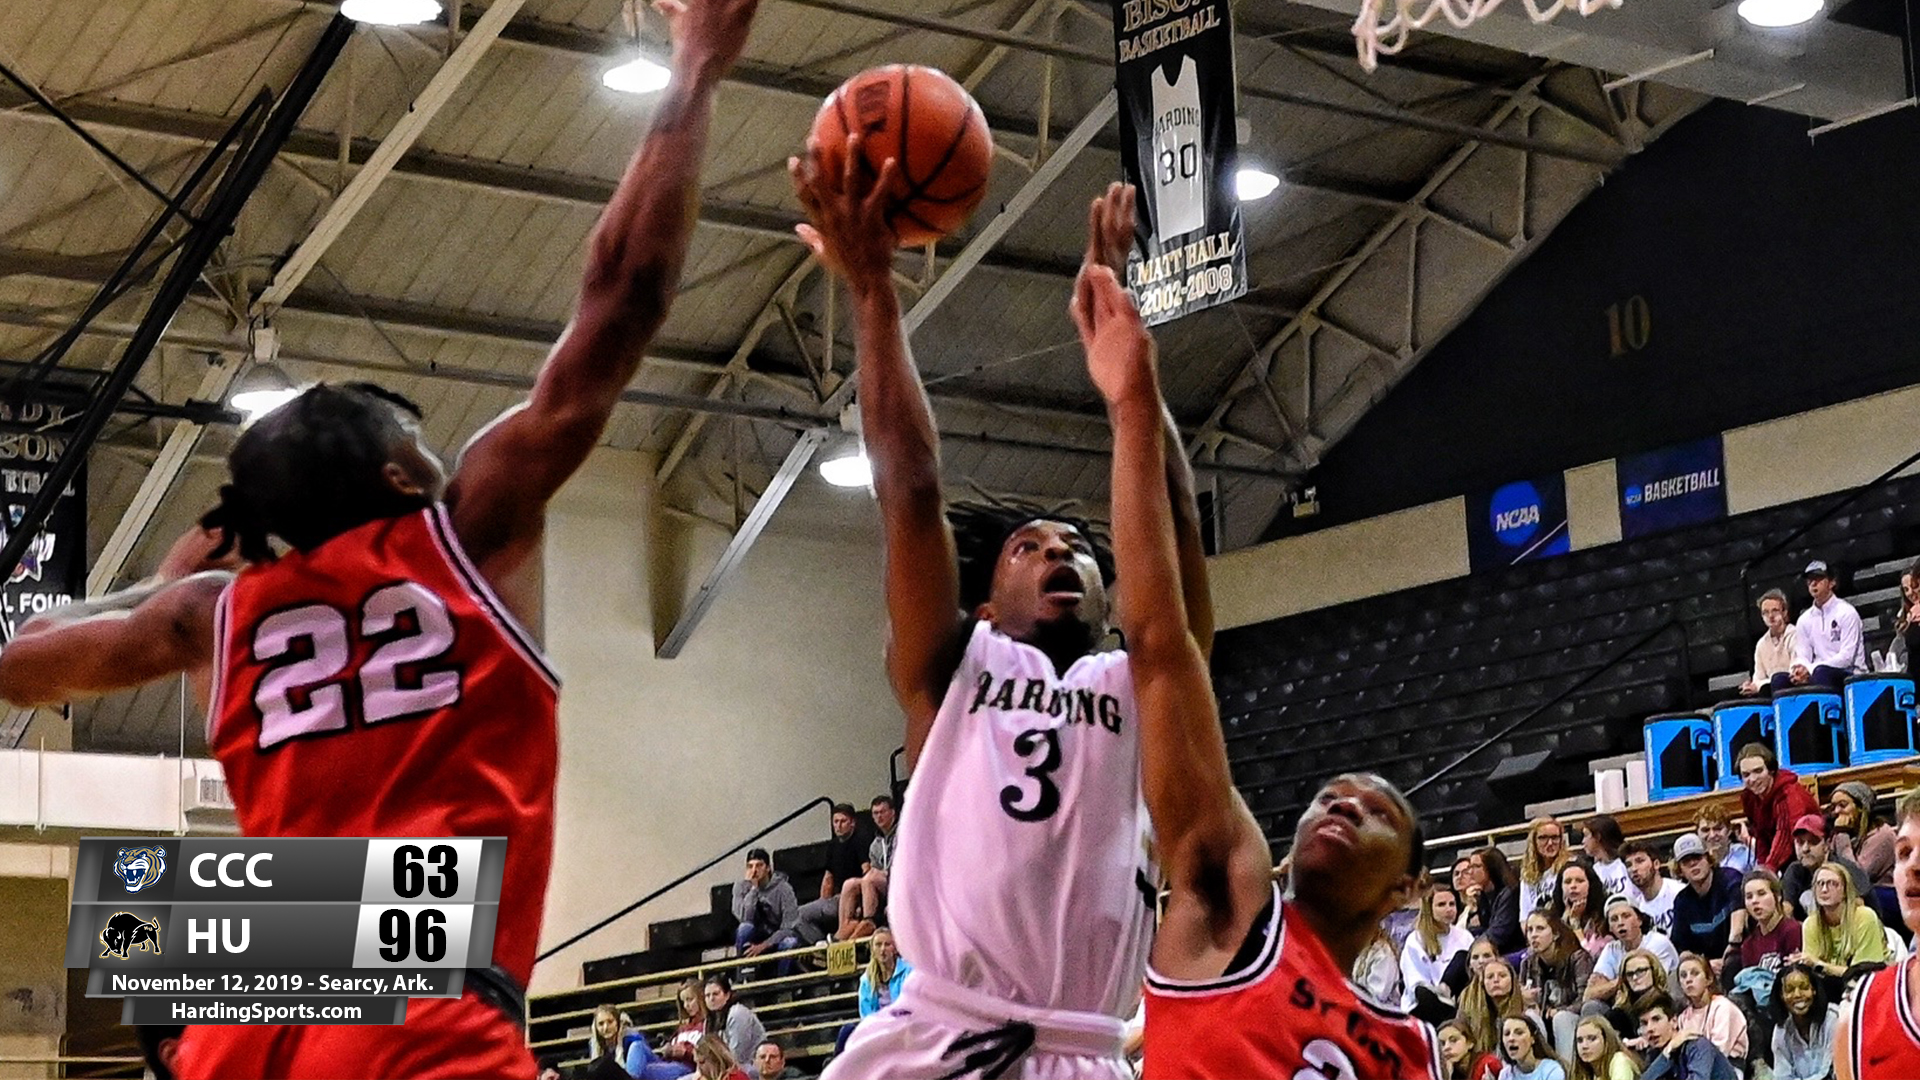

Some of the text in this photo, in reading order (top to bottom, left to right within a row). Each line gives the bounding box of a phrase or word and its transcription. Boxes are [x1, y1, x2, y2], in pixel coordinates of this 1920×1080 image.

[1119, 5, 1220, 63] BASKETBALL
[1160, 142, 1197, 187] 30
[1136, 231, 1236, 286] MATT HALL
[1140, 264, 1233, 317] 2002-2008
[1604, 295, 1650, 357] 10
[1625, 468, 1721, 505] NCAA BASKETBALL
[1495, 504, 1540, 533] NCAA
[252, 580, 461, 750] 22
[1000, 728, 1063, 822] 3
[828, 948, 855, 970] HOME
